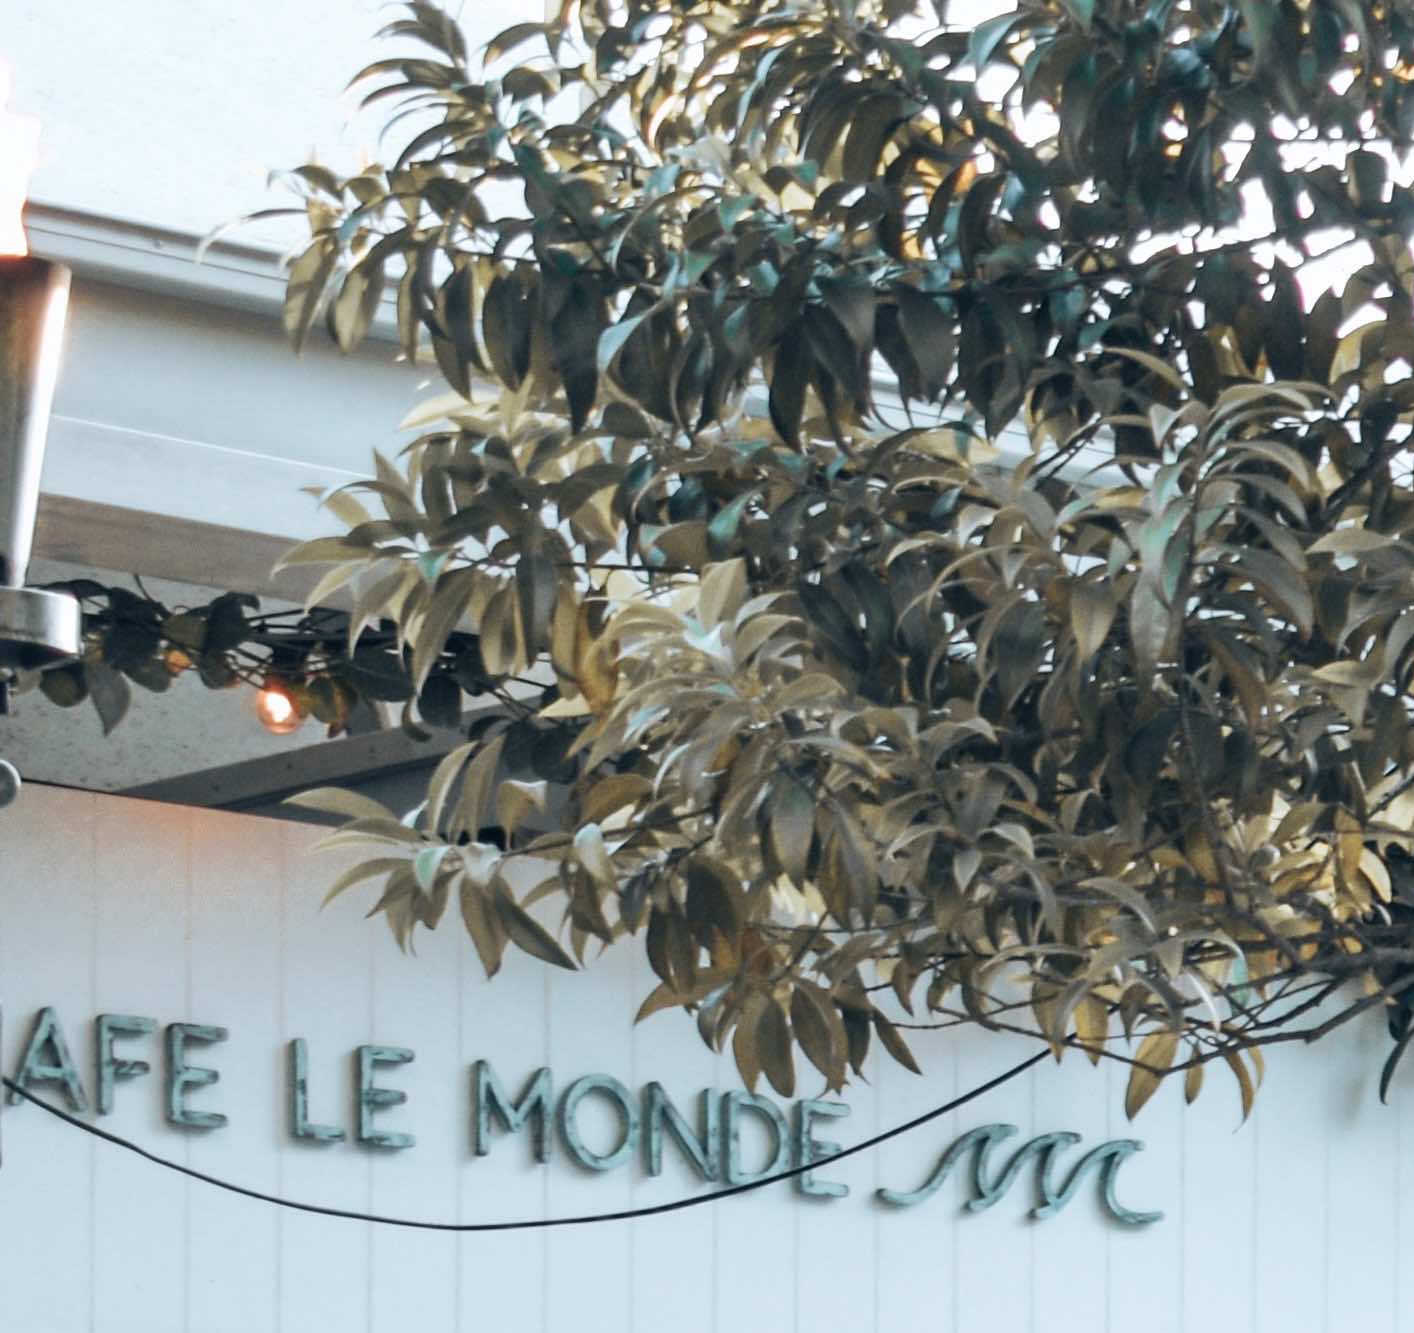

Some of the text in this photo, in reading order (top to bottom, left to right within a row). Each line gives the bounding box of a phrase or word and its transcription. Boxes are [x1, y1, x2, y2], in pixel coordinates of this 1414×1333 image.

[5, 1007, 851, 1199] AFE LE MONDE
